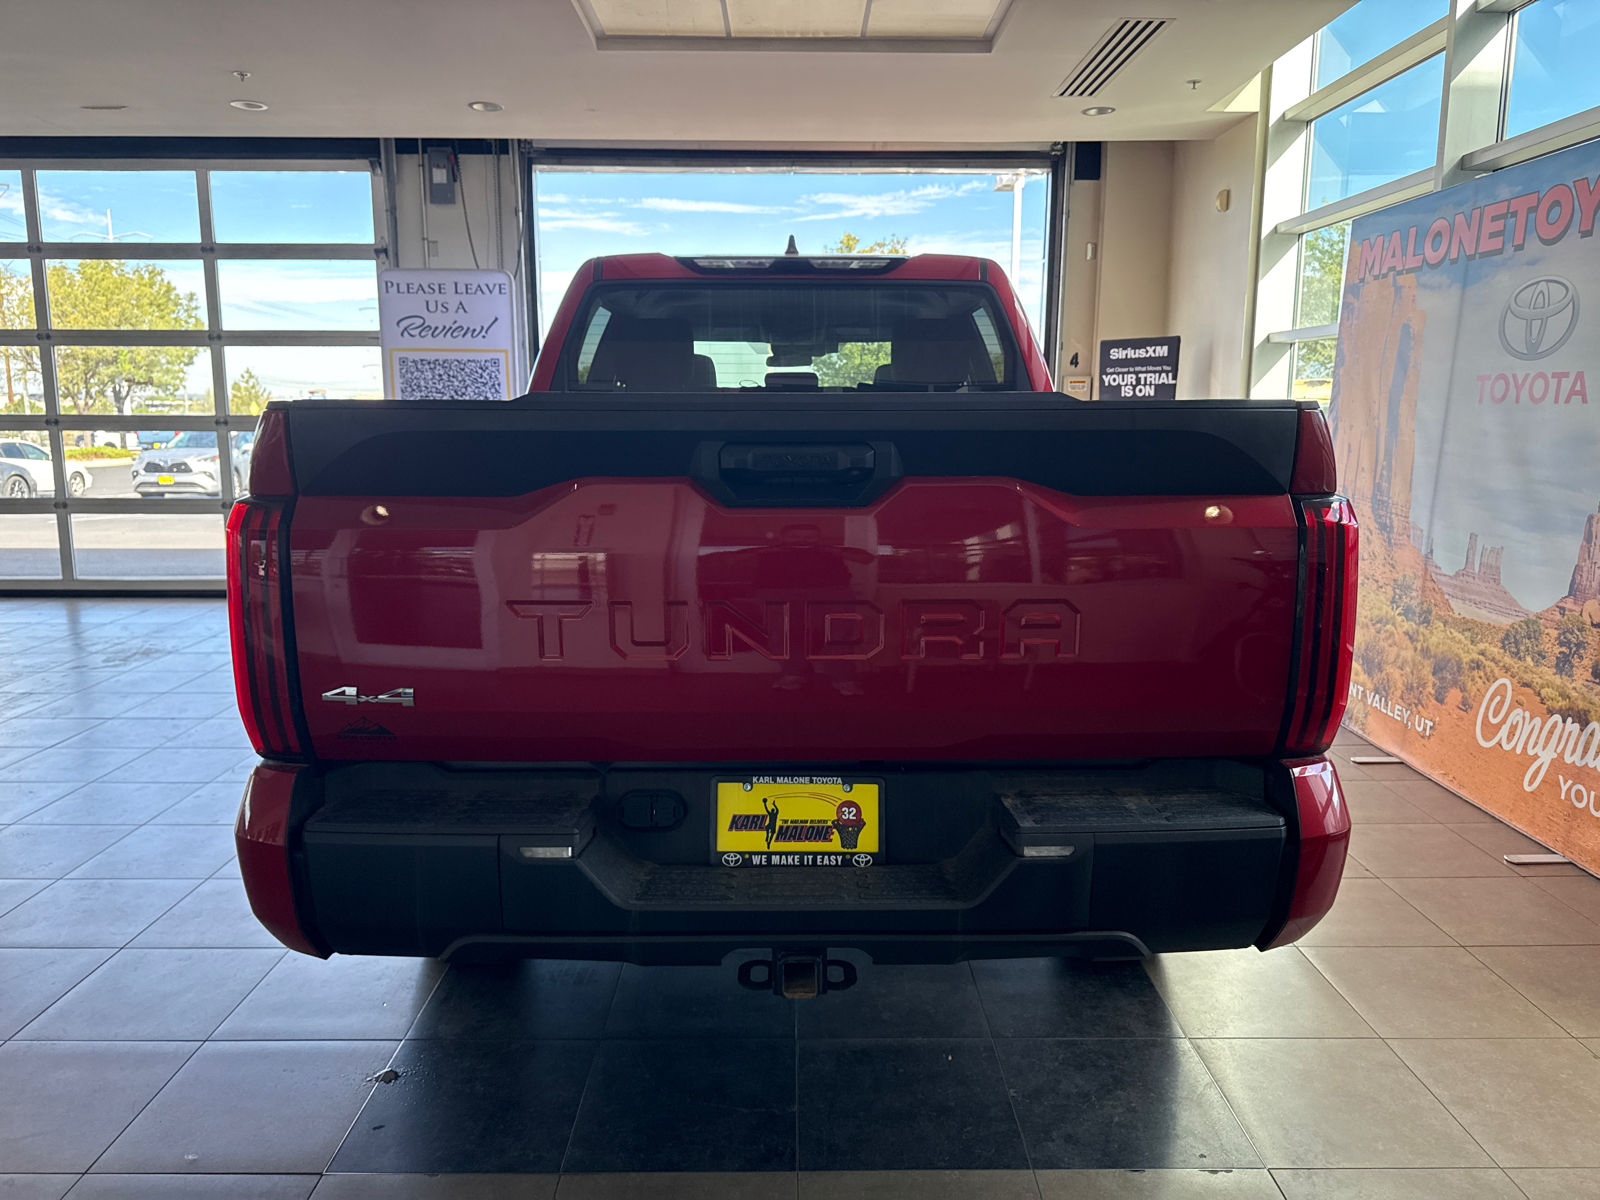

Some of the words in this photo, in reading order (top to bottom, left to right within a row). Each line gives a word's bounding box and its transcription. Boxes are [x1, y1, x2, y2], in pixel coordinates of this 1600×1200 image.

[455, 301, 468, 314] A
[396, 315, 499, 339] Review!
[1069, 352, 1080, 369] 4
[1109, 345, 1169, 360] SiriusXM
[1102, 374, 1136, 386] YOUR
[1138, 373, 1176, 385] TRIAL
[1476, 371, 1588, 404] TOYOTA
[1121, 386, 1133, 397] IS
[1135, 385, 1155, 397] ON
[761, 454, 832, 468] TOYOTA
[506, 599, 1080, 661] TUNDRA
[1366, 689, 1411, 729] VALLEY,
[1414, 714, 1434, 736] UT
[1476, 677, 1600, 792] Congra
[752, 776, 774, 784] KARL
[776, 777, 810, 785] MALONE
[812, 777, 843, 785] TOYOTA
[841, 807, 857, 820] 32
[728, 814, 769, 831] KARL
[774, 825, 834, 842] MALONE
[752, 855, 767, 866] WE
[771, 855, 800, 866] MAKE
[804, 855, 813, 866] IT
[817, 855, 843, 866] EASY
